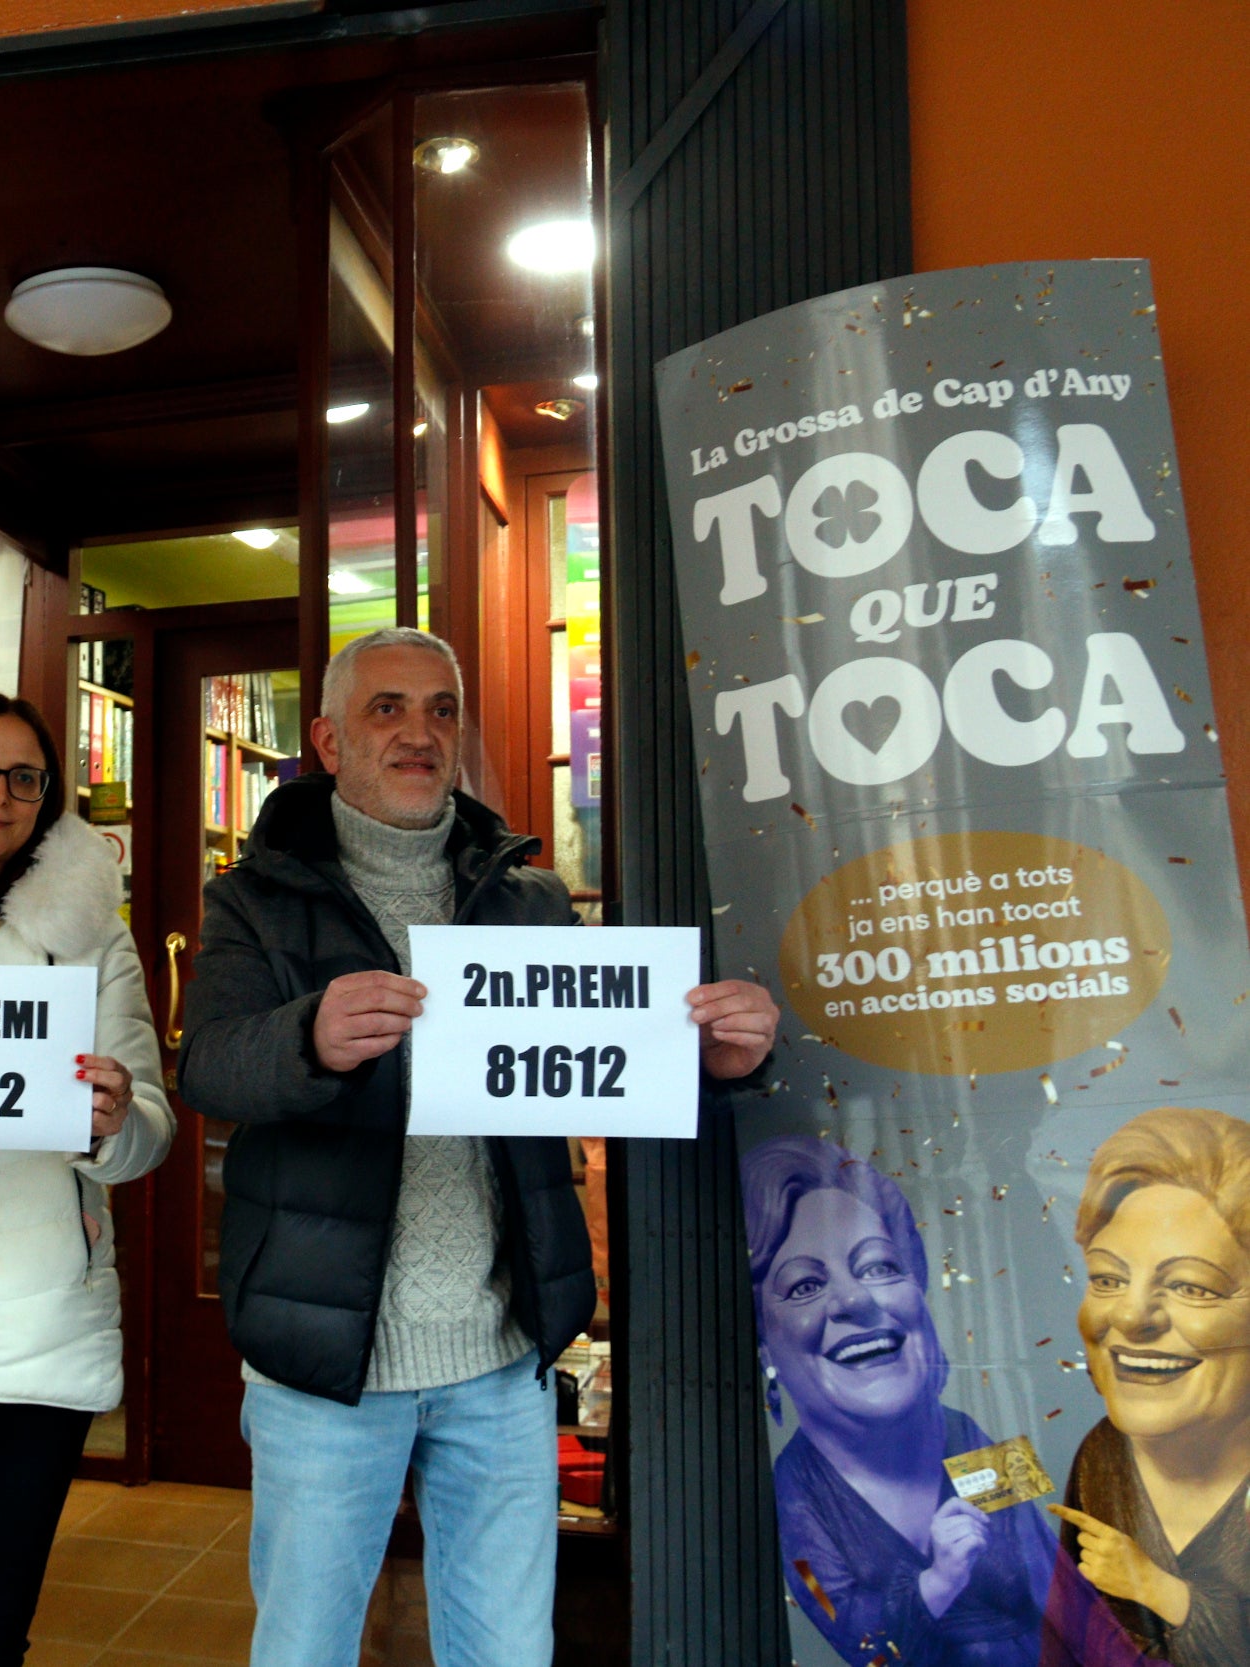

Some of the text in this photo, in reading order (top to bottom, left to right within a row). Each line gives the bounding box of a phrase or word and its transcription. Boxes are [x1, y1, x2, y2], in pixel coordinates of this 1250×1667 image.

[690, 447, 728, 476] La
[734, 403, 863, 456] Grossa
[873, 389, 923, 420] de
[933, 375, 1014, 409] Cap
[693, 423, 1156, 606] TOCA
[849, 573, 998, 643] QUE
[714, 632, 1186, 802] TOCA
[879, 870, 981, 906] perquè
[989, 870, 1009, 890] a
[1015, 865, 1073, 887] tots
[849, 897, 1082, 942] ja ens han tocat
[463, 962, 650, 1009] 2n.PREMI
[816, 933, 1130, 988] 300 milions
[825, 971, 1130, 1018] en accions socials
[486, 1044, 627, 1098] 81612
